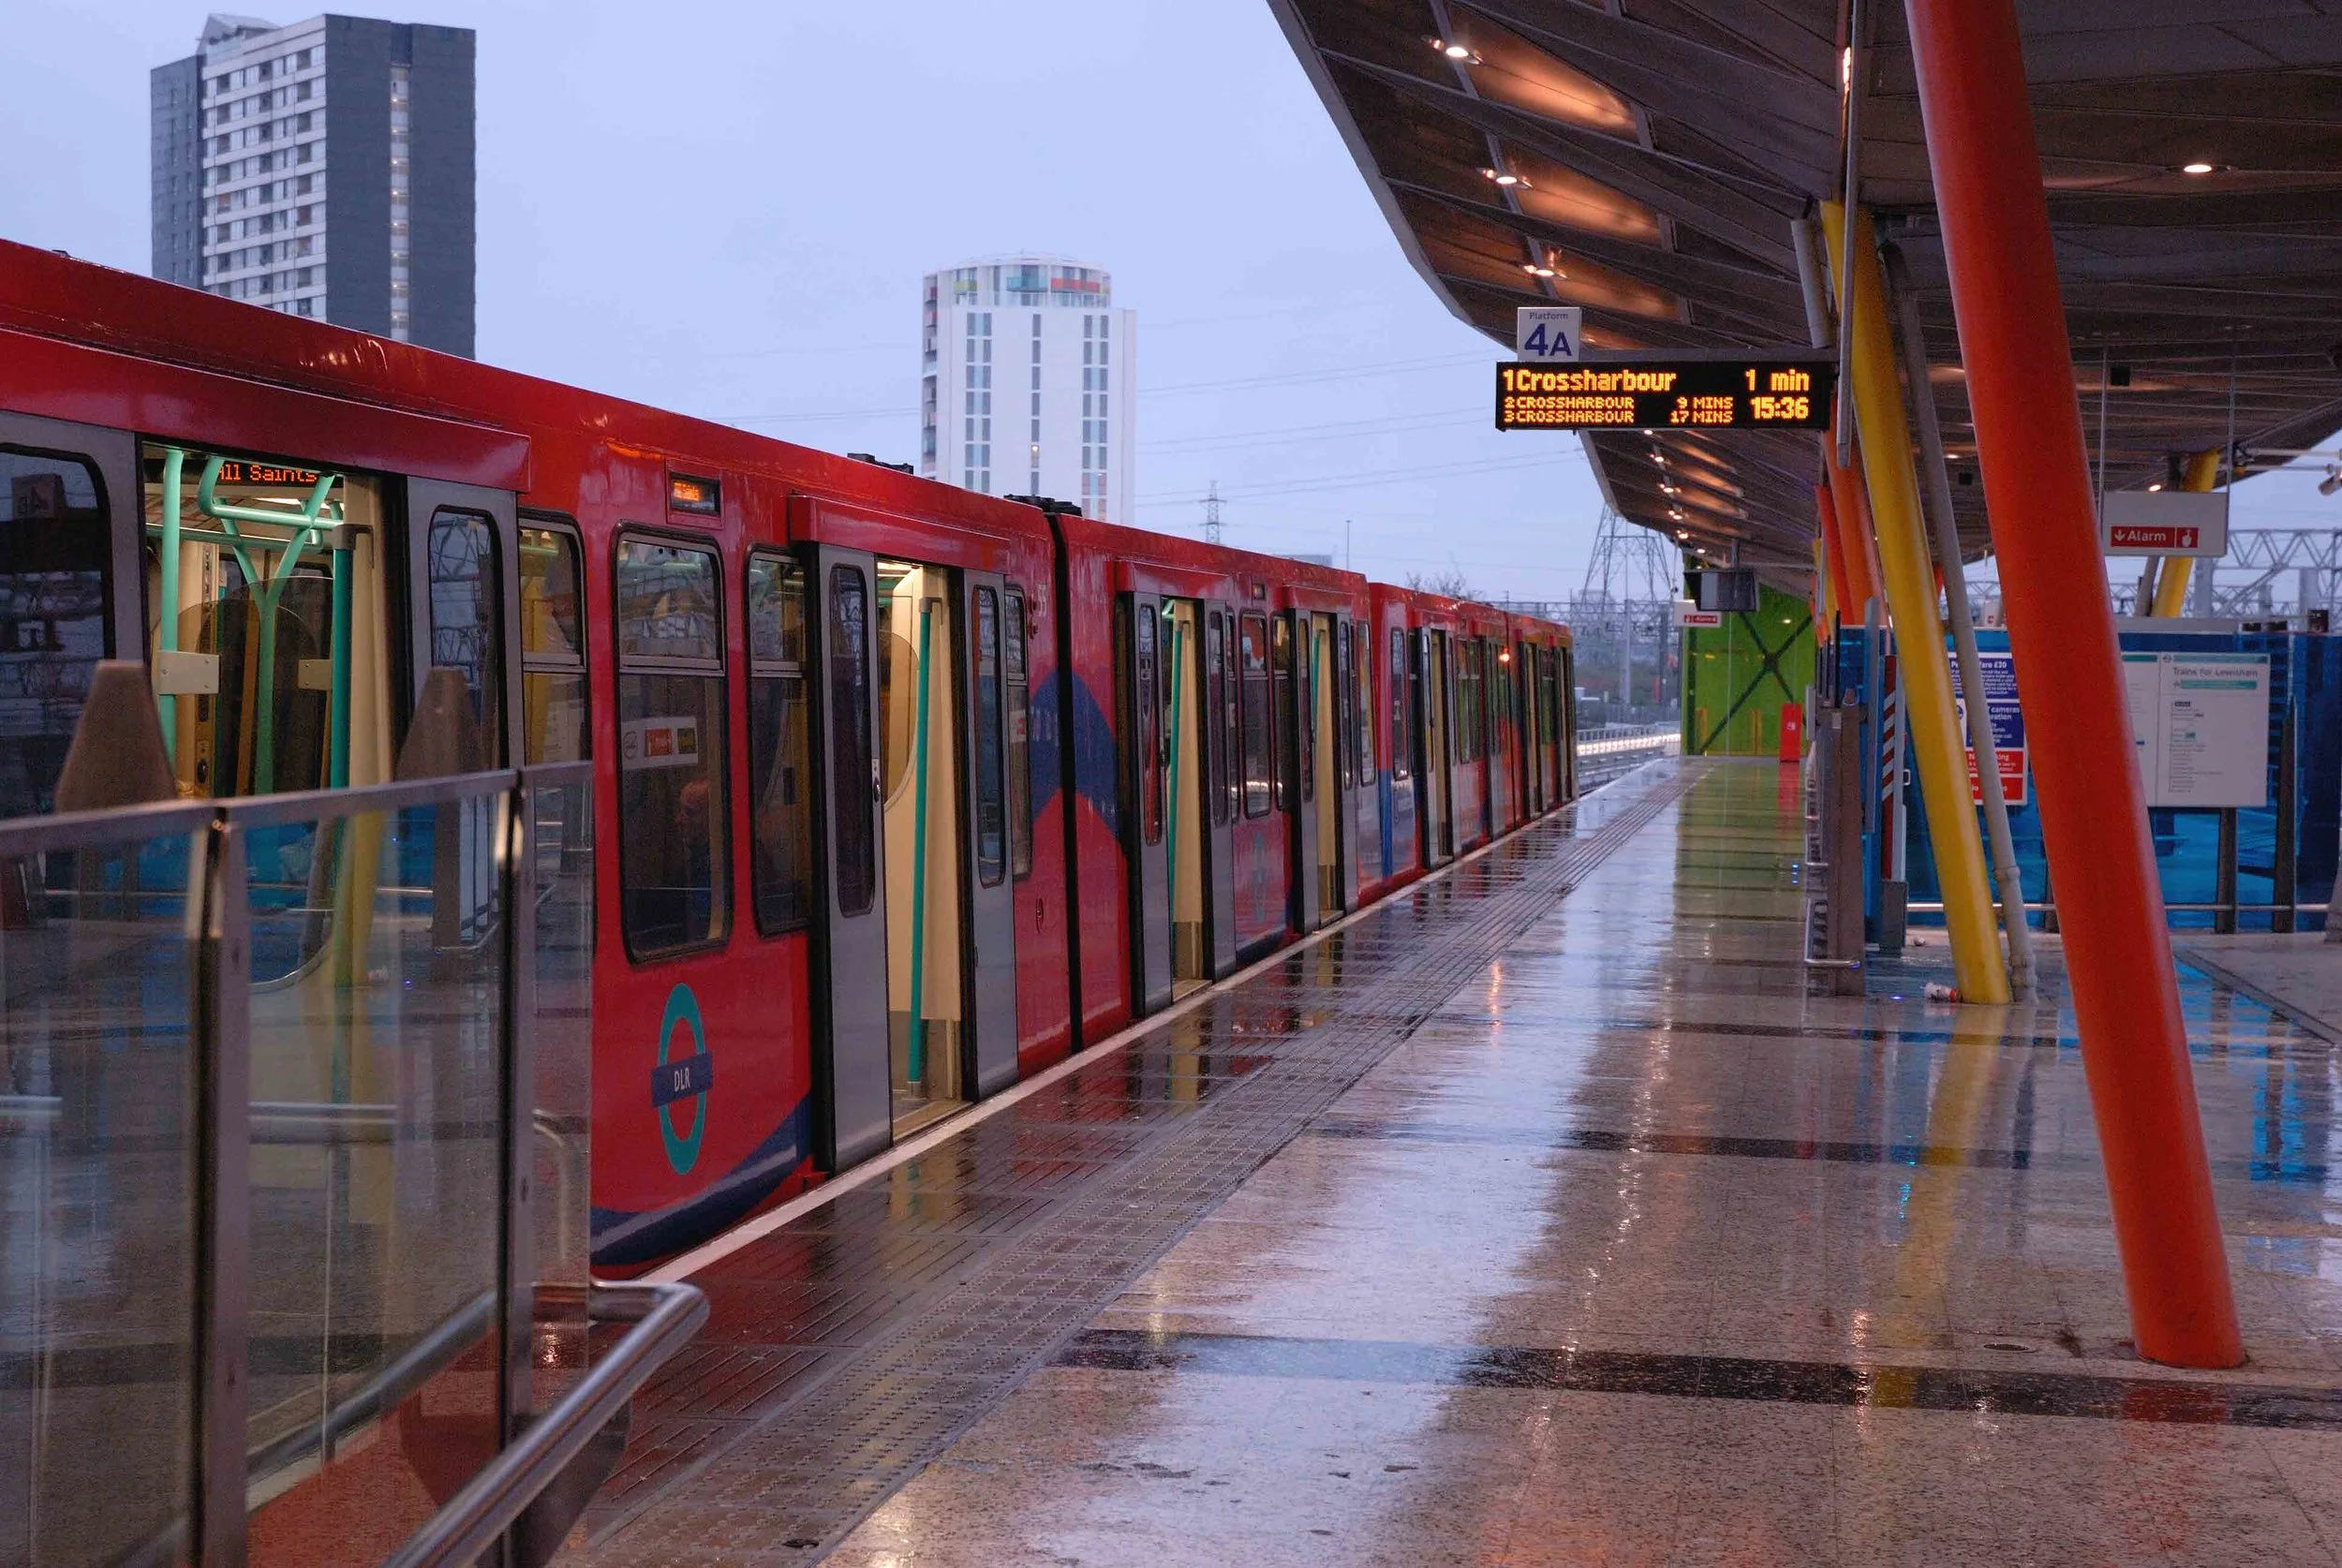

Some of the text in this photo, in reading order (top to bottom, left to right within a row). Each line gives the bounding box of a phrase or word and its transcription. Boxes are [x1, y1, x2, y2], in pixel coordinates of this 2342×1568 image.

[1529, 311, 1568, 320] Platform
[1524, 323, 1573, 357] 4A
[1745, 369, 1756, 392] 1
[1771, 368, 1810, 392] min
[1670, 410, 1689, 423] 17
[1692, 410, 1733, 423] MINS
[1677, 396, 1688, 409] 9
[1693, 396, 1733, 409] MINS
[1750, 396, 1809, 420] 15:36
[249, 465, 317, 482] Saints
[2127, 530, 2167, 541] Alarm
[2173, 667, 2258, 677] Trains for Lewisham
[674, 1067, 690, 1092] DLR
